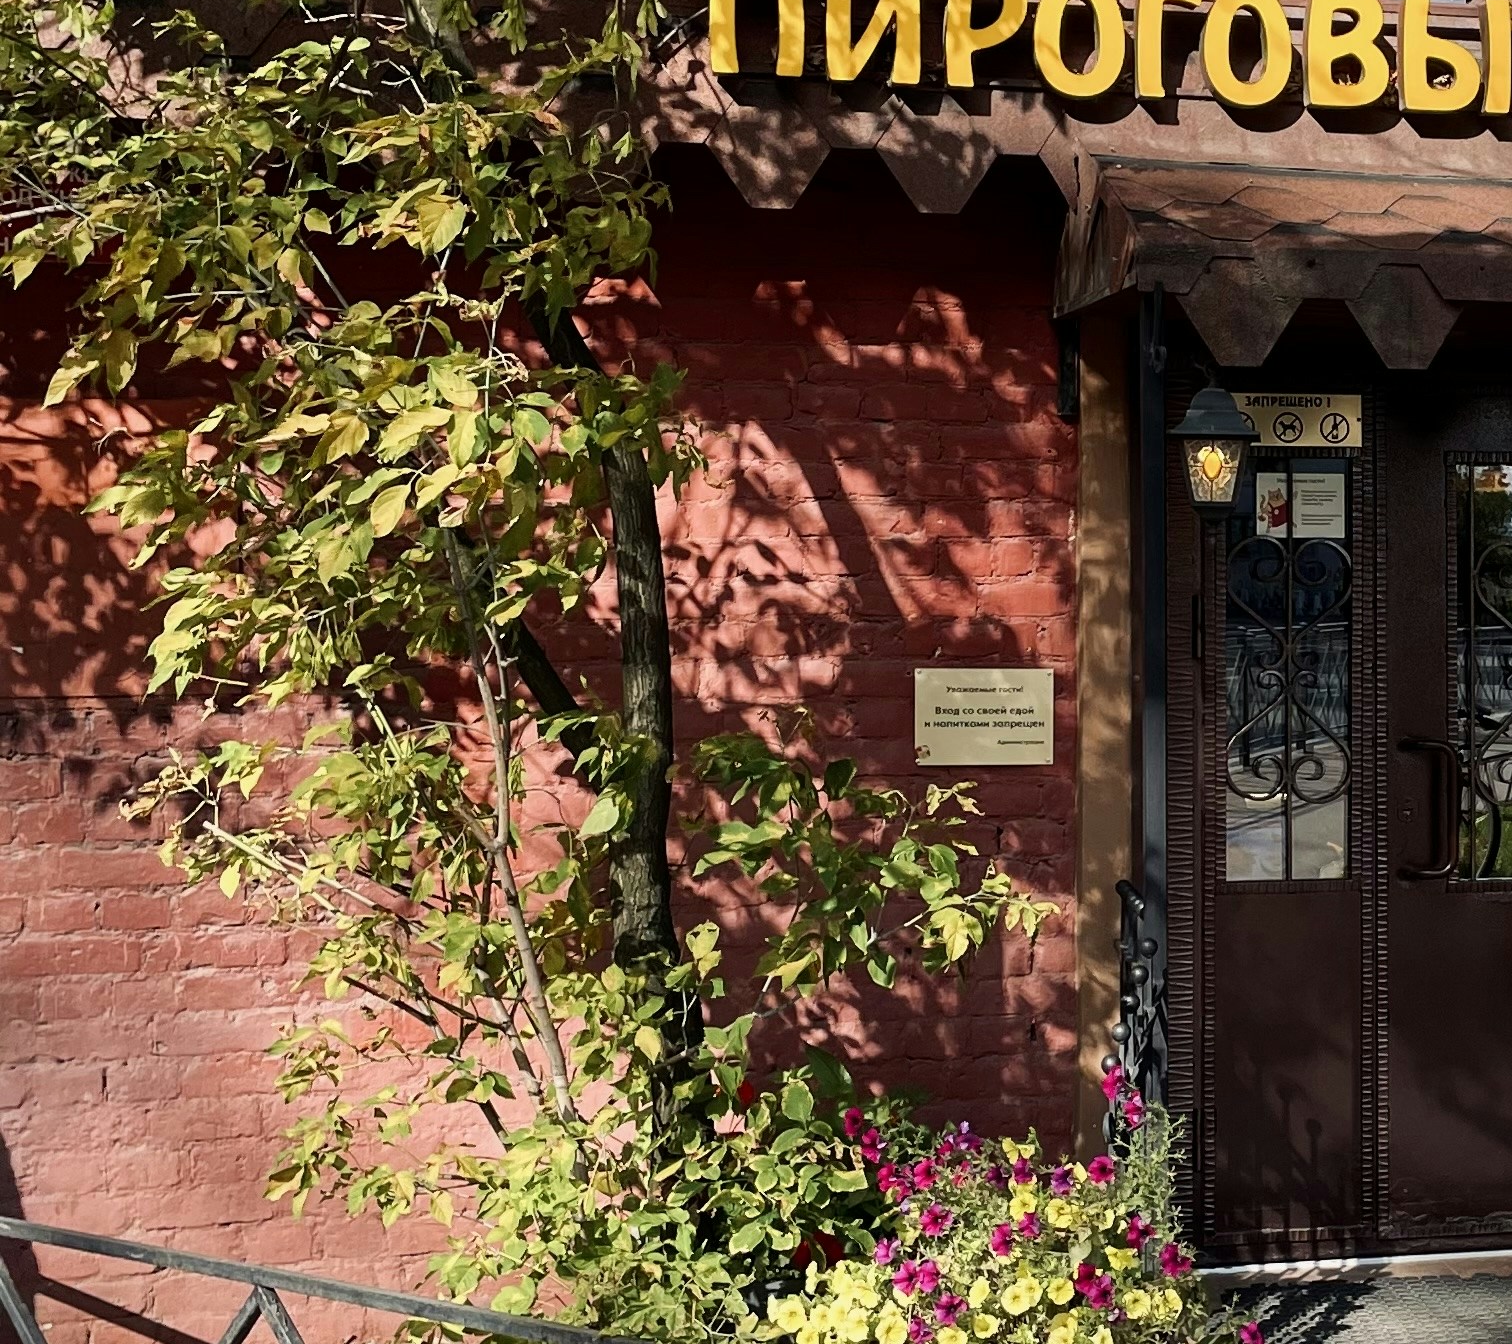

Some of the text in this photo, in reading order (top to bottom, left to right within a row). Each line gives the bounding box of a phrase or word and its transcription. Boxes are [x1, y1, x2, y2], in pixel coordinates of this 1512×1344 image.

[935, 707, 959, 716] Вход
[977, 706, 1007, 715] своей
[1009, 706, 1034, 717] едой
[933, 720, 989, 728] напитками
[992, 721, 1045, 730] запрещен
